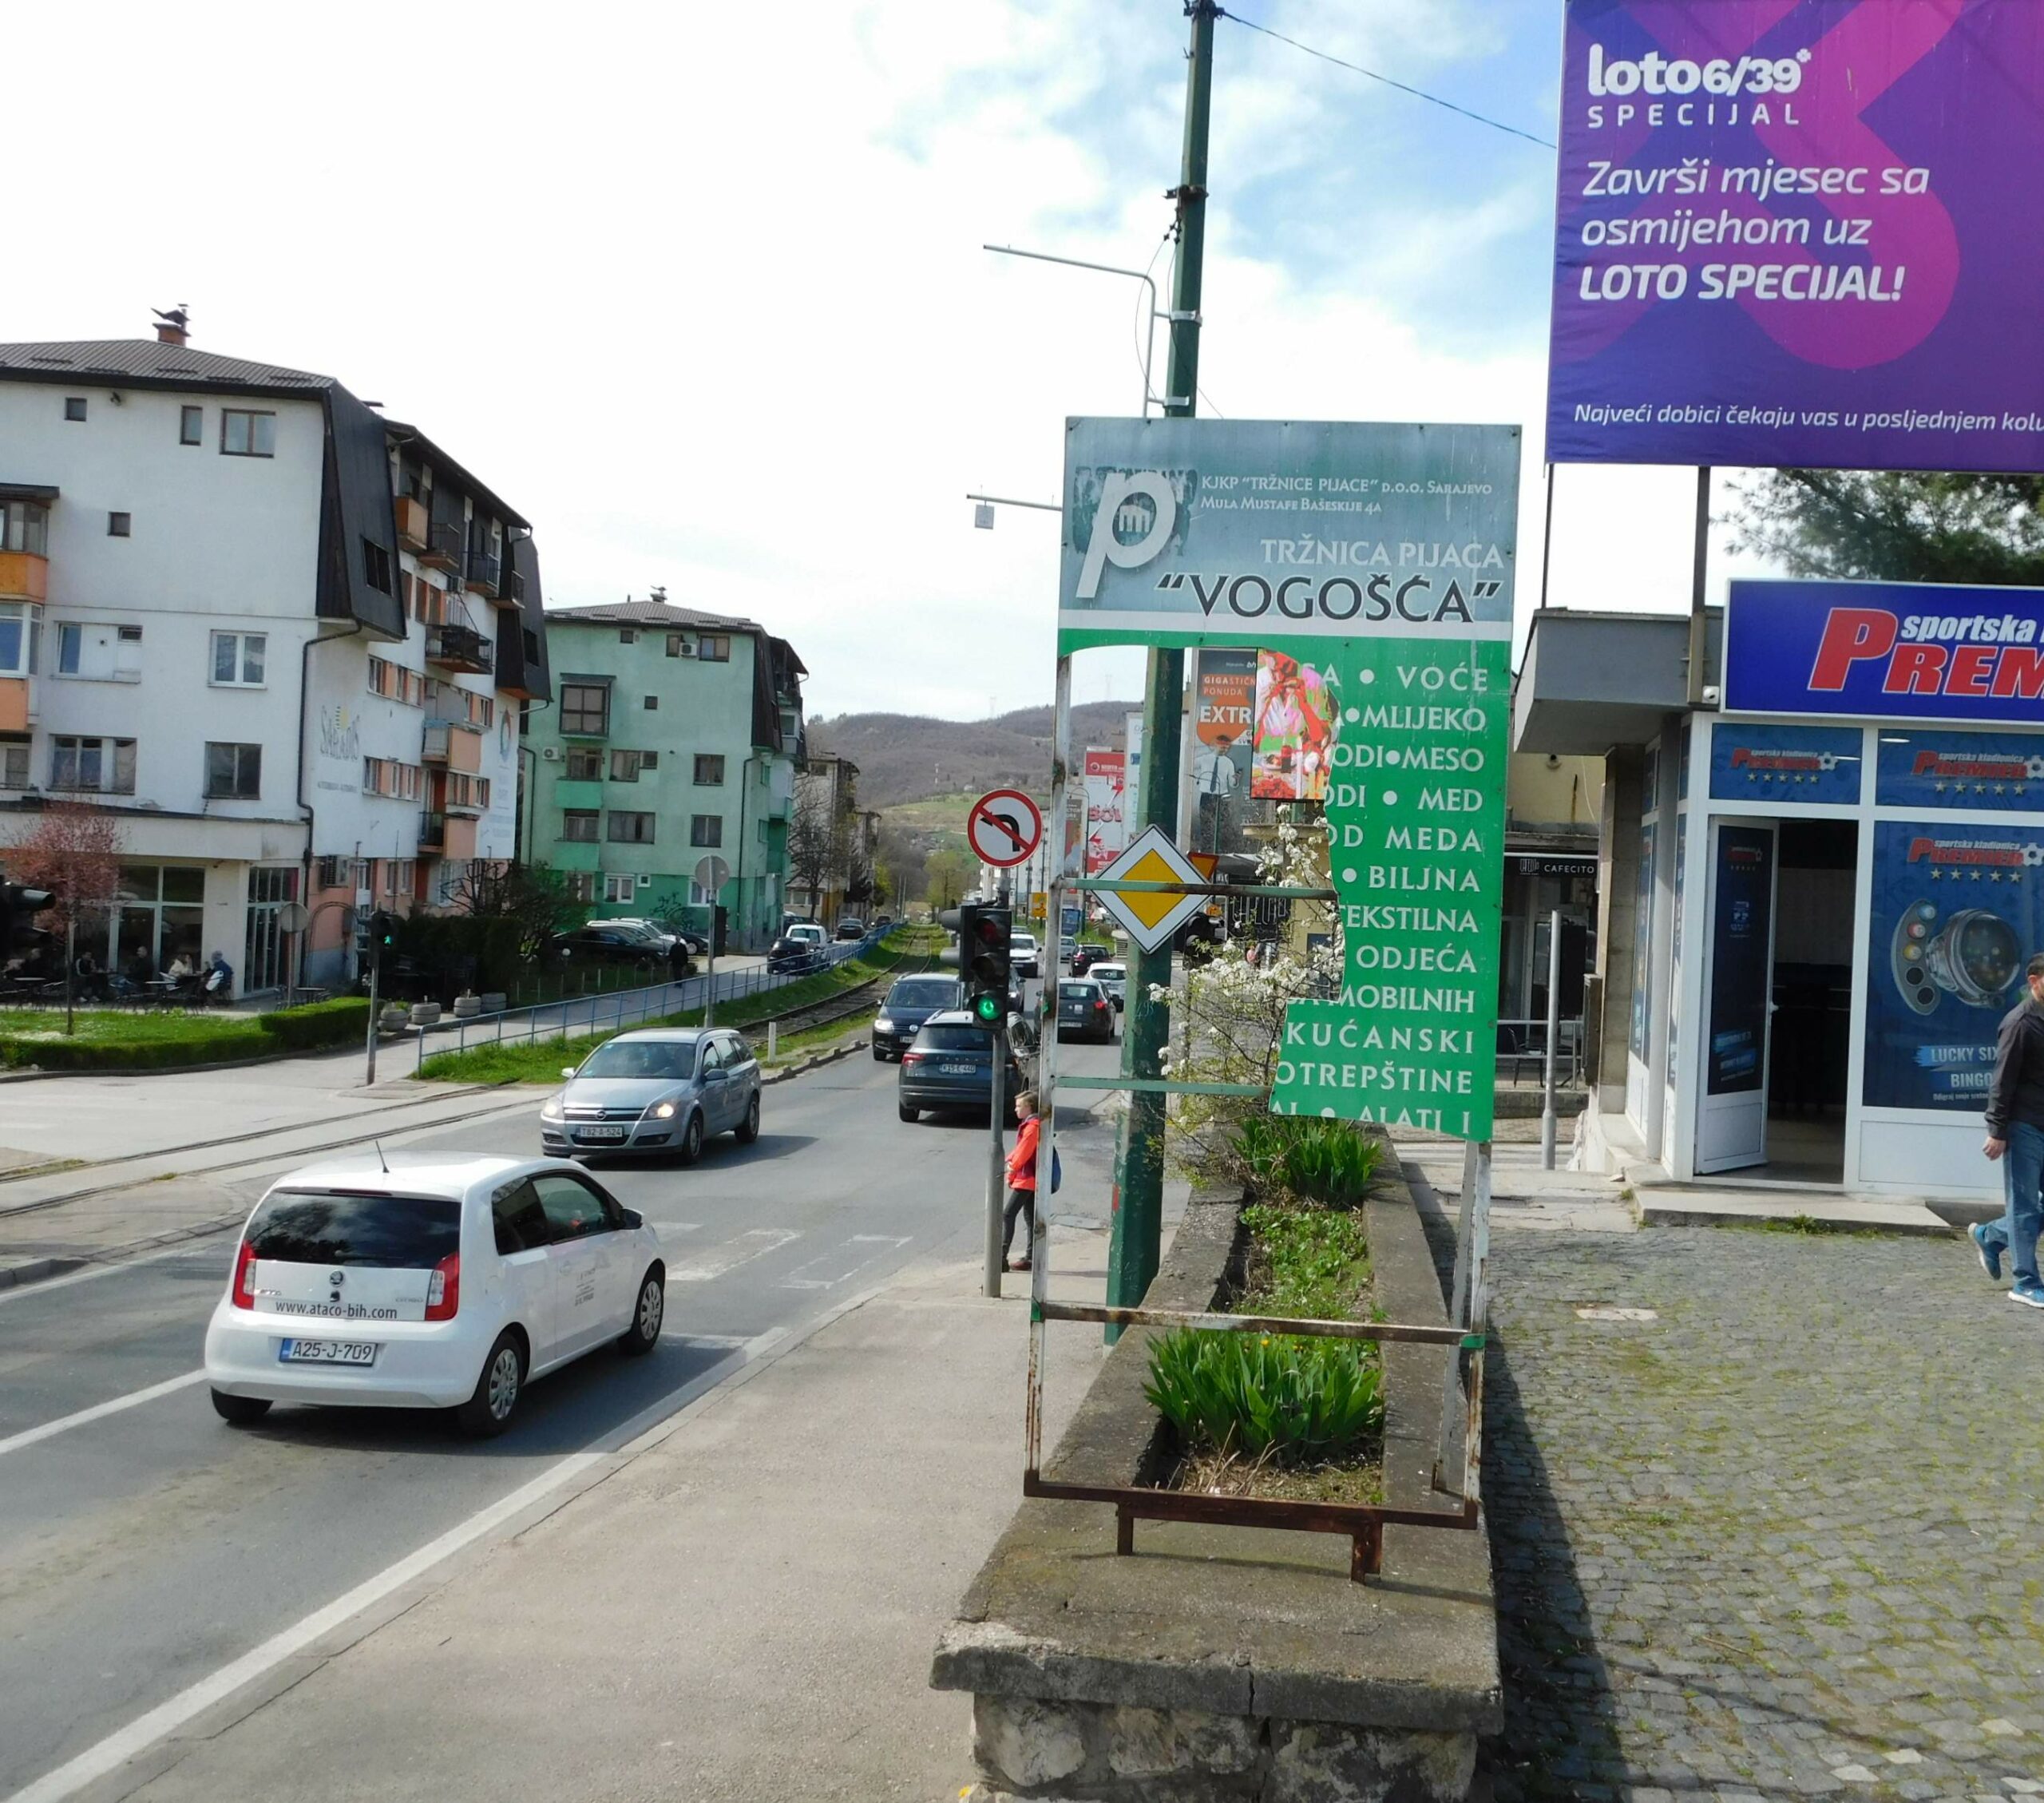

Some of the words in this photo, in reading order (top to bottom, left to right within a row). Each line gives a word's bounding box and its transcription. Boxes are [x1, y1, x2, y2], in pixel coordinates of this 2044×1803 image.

[1588, 104, 1800, 128] SPECIJAL
[1583, 158, 1710, 196] Završi
[1721, 159, 1868, 201] mjesec
[1880, 167, 1930, 195] sa
[1581, 209, 1810, 252] osmijehom
[1823, 217, 1872, 245] uz
[1579, 264, 1688, 300] LOTO
[1697, 264, 1906, 302] SPECIJAL!
[1574, 403, 1653, 426] Najveći
[1657, 404, 1721, 424] dobici
[1725, 405, 1796, 429] čekaju
[1801, 411, 1839, 427] vas
[1844, 412, 1858, 427] u
[1862, 410, 1996, 434] posljednjem
[1202, 477, 1239, 490] KJKP
[1260, 533, 1392, 566] TRŽNICA
[1397, 542, 1505, 569] PIJACA
[1901, 614, 2037, 642] sportska
[1396, 662, 1487, 691] VOĆE
[1362, 704, 1486, 731] MLIJEKO
[1401, 746, 1484, 772] MESO
[1417, 787, 1483, 812] MED
[1384, 826, 1482, 853] MEDA
[1369, 866, 1481, 893] BILJNA
[1543, 865, 1594, 874] CAFECITO
[1356, 942, 1477, 973] ODJEĆA
[1286, 1018, 1473, 1054] KUĆANSKI
[1931, 1047, 1975, 1062] LUCKY
[1951, 1072, 1993, 1088] BINGO
[275, 1302, 398, 1319] www.ataco-bih.com
[292, 1341, 372, 1361] A25-J-709
